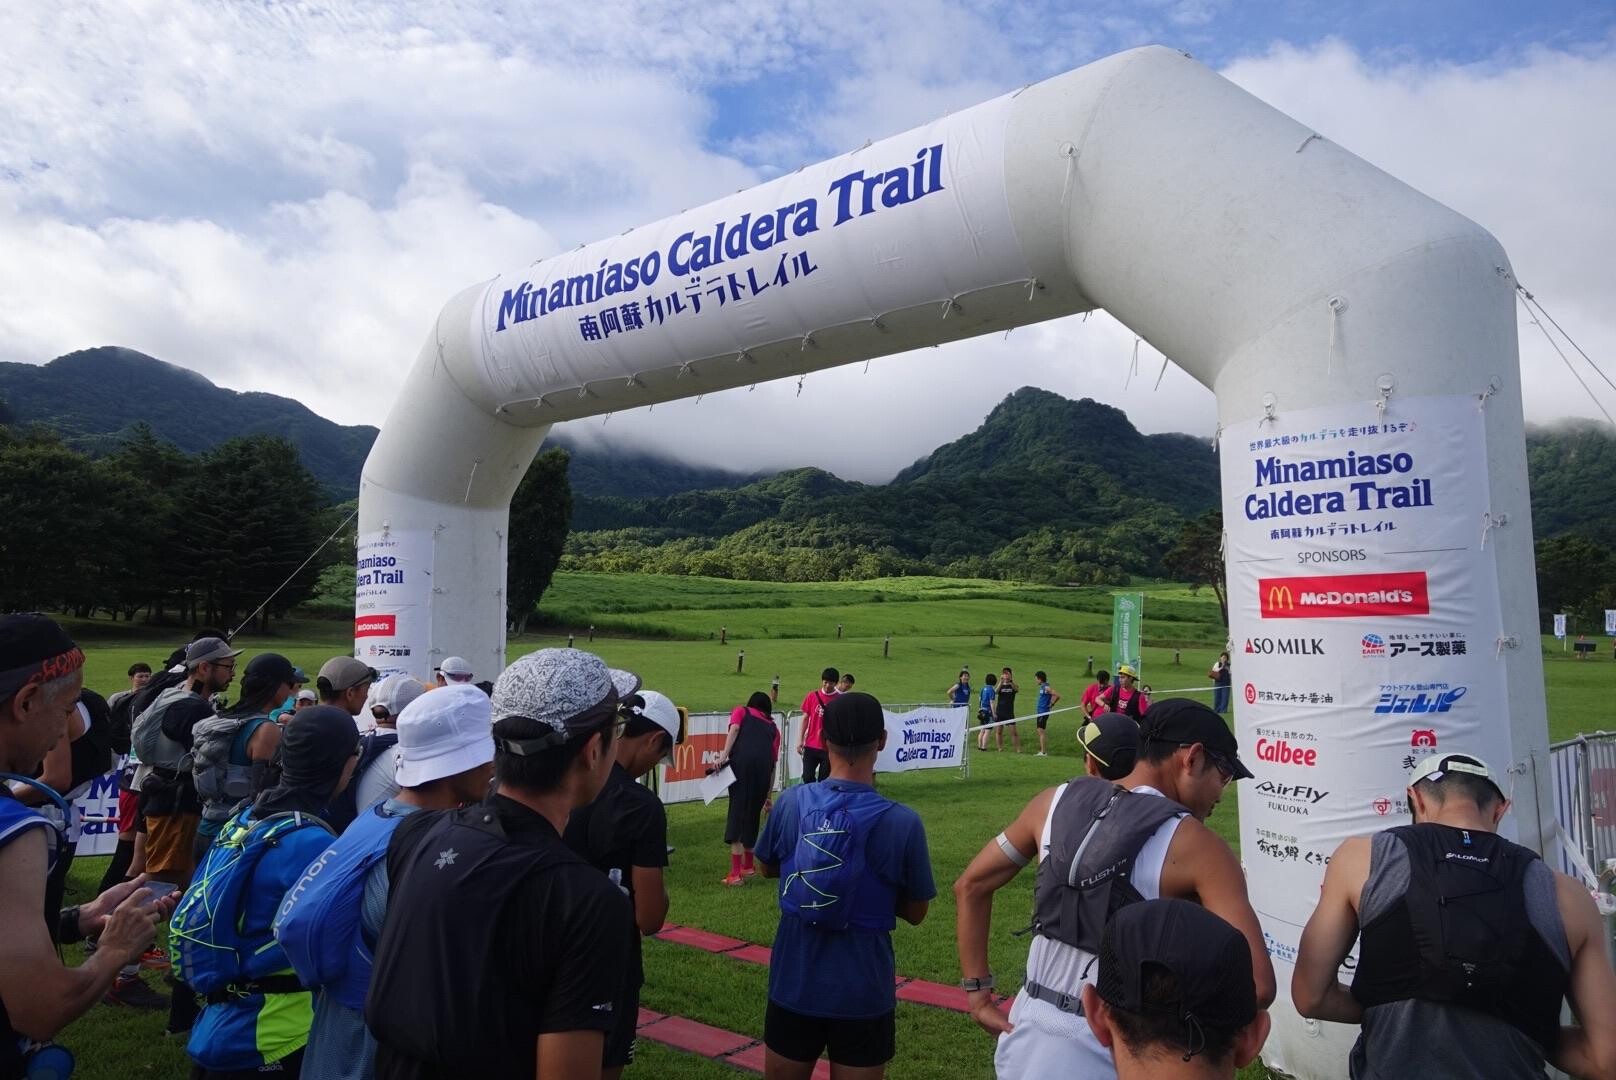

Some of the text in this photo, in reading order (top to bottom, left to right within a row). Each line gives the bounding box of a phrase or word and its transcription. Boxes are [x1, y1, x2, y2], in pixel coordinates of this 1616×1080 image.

[495, 144, 945, 332] Minamiaso Caldera Trail
[578, 250, 818, 341] 南阿蘇カルデラトレイル
[1255, 450, 1413, 487] Minamiaso
[1245, 478, 1434, 521] Caldera Trail
[1297, 549, 1367, 564] SPONSORS
[373, 569, 404, 584] Trail
[1300, 589, 1413, 605] McDonald's
[1277, 638, 1325, 655] MILK
[1390, 640, 1467, 657] アース製薬
[931, 745, 956, 760] Trail
[1256, 738, 1317, 766] Calbee
[1256, 781, 1330, 803] AirFly
[1267, 801, 1309, 815] FUKUOKA
